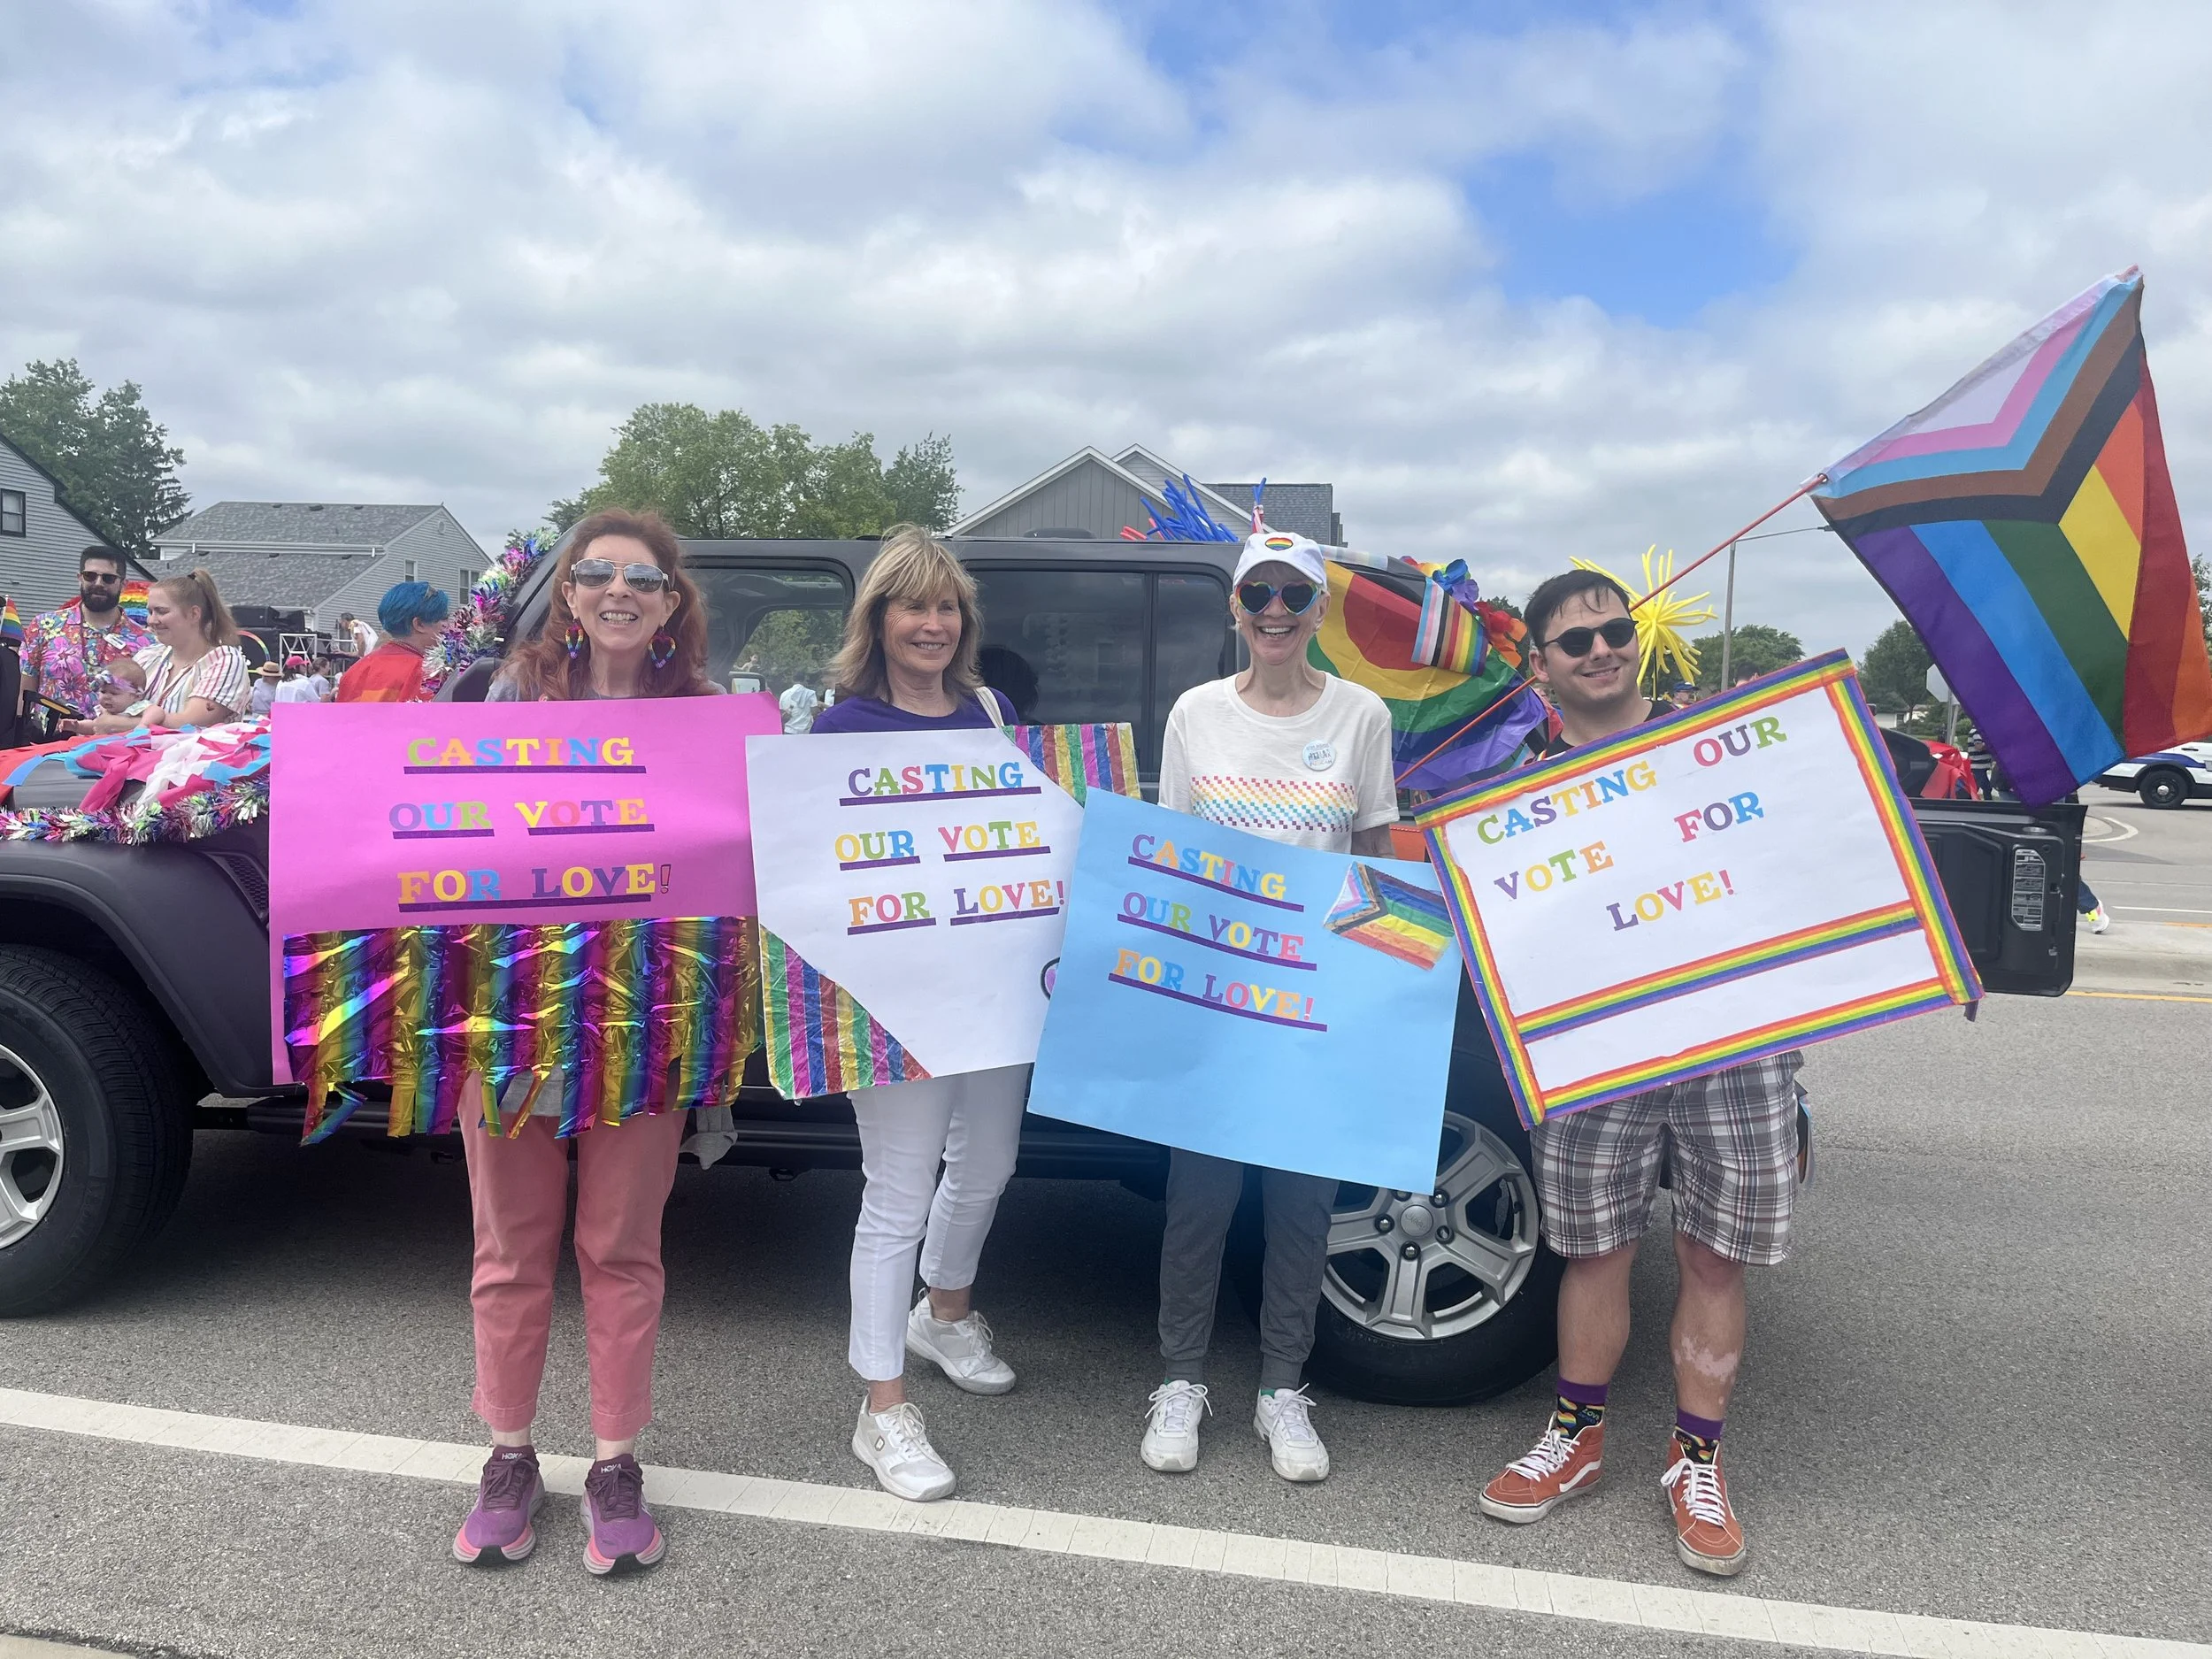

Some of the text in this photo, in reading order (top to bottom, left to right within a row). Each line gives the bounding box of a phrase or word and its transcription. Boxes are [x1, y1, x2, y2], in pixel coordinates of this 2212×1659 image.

[407, 737, 634, 766] CASTING
[848, 762, 1024, 796] CASTING
[1477, 716, 1786, 845] CASTING OUR
[388, 799, 647, 831] OUR VOTE
[834, 821, 1041, 863] OUR VOTE
[1132, 833, 1286, 901] CASTING
[1494, 791, 1764, 901] VOTE FOR
[397, 863, 672, 904] FOR LOVE!
[849, 880, 1064, 926] FOR LOVE!
[1606, 869, 1735, 932] LOVE!
[1123, 891, 1304, 962] OUR VOTE
[1113, 949, 1314, 1021] FOR LOVE!
